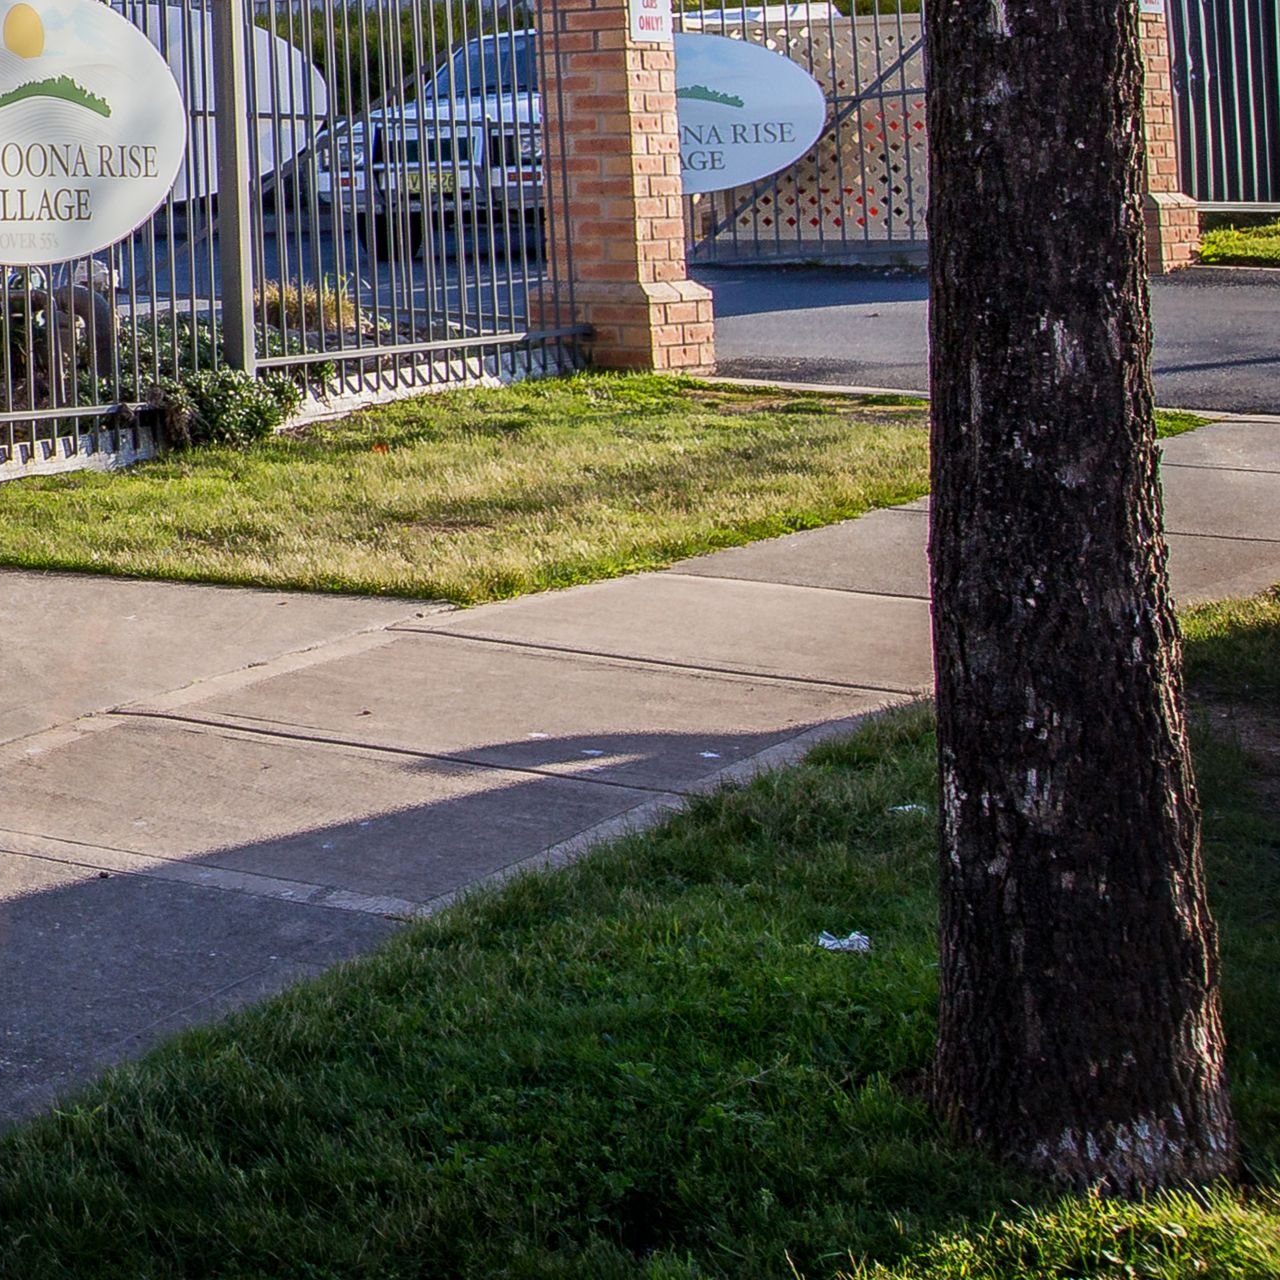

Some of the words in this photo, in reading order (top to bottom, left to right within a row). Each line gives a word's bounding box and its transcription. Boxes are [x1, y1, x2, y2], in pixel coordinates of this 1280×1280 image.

[638, 15, 664, 32] ONLY!
[731, 122, 796, 144] RISE
[97, 144, 159, 178] RISE
[0, 232, 37, 250] OVER
